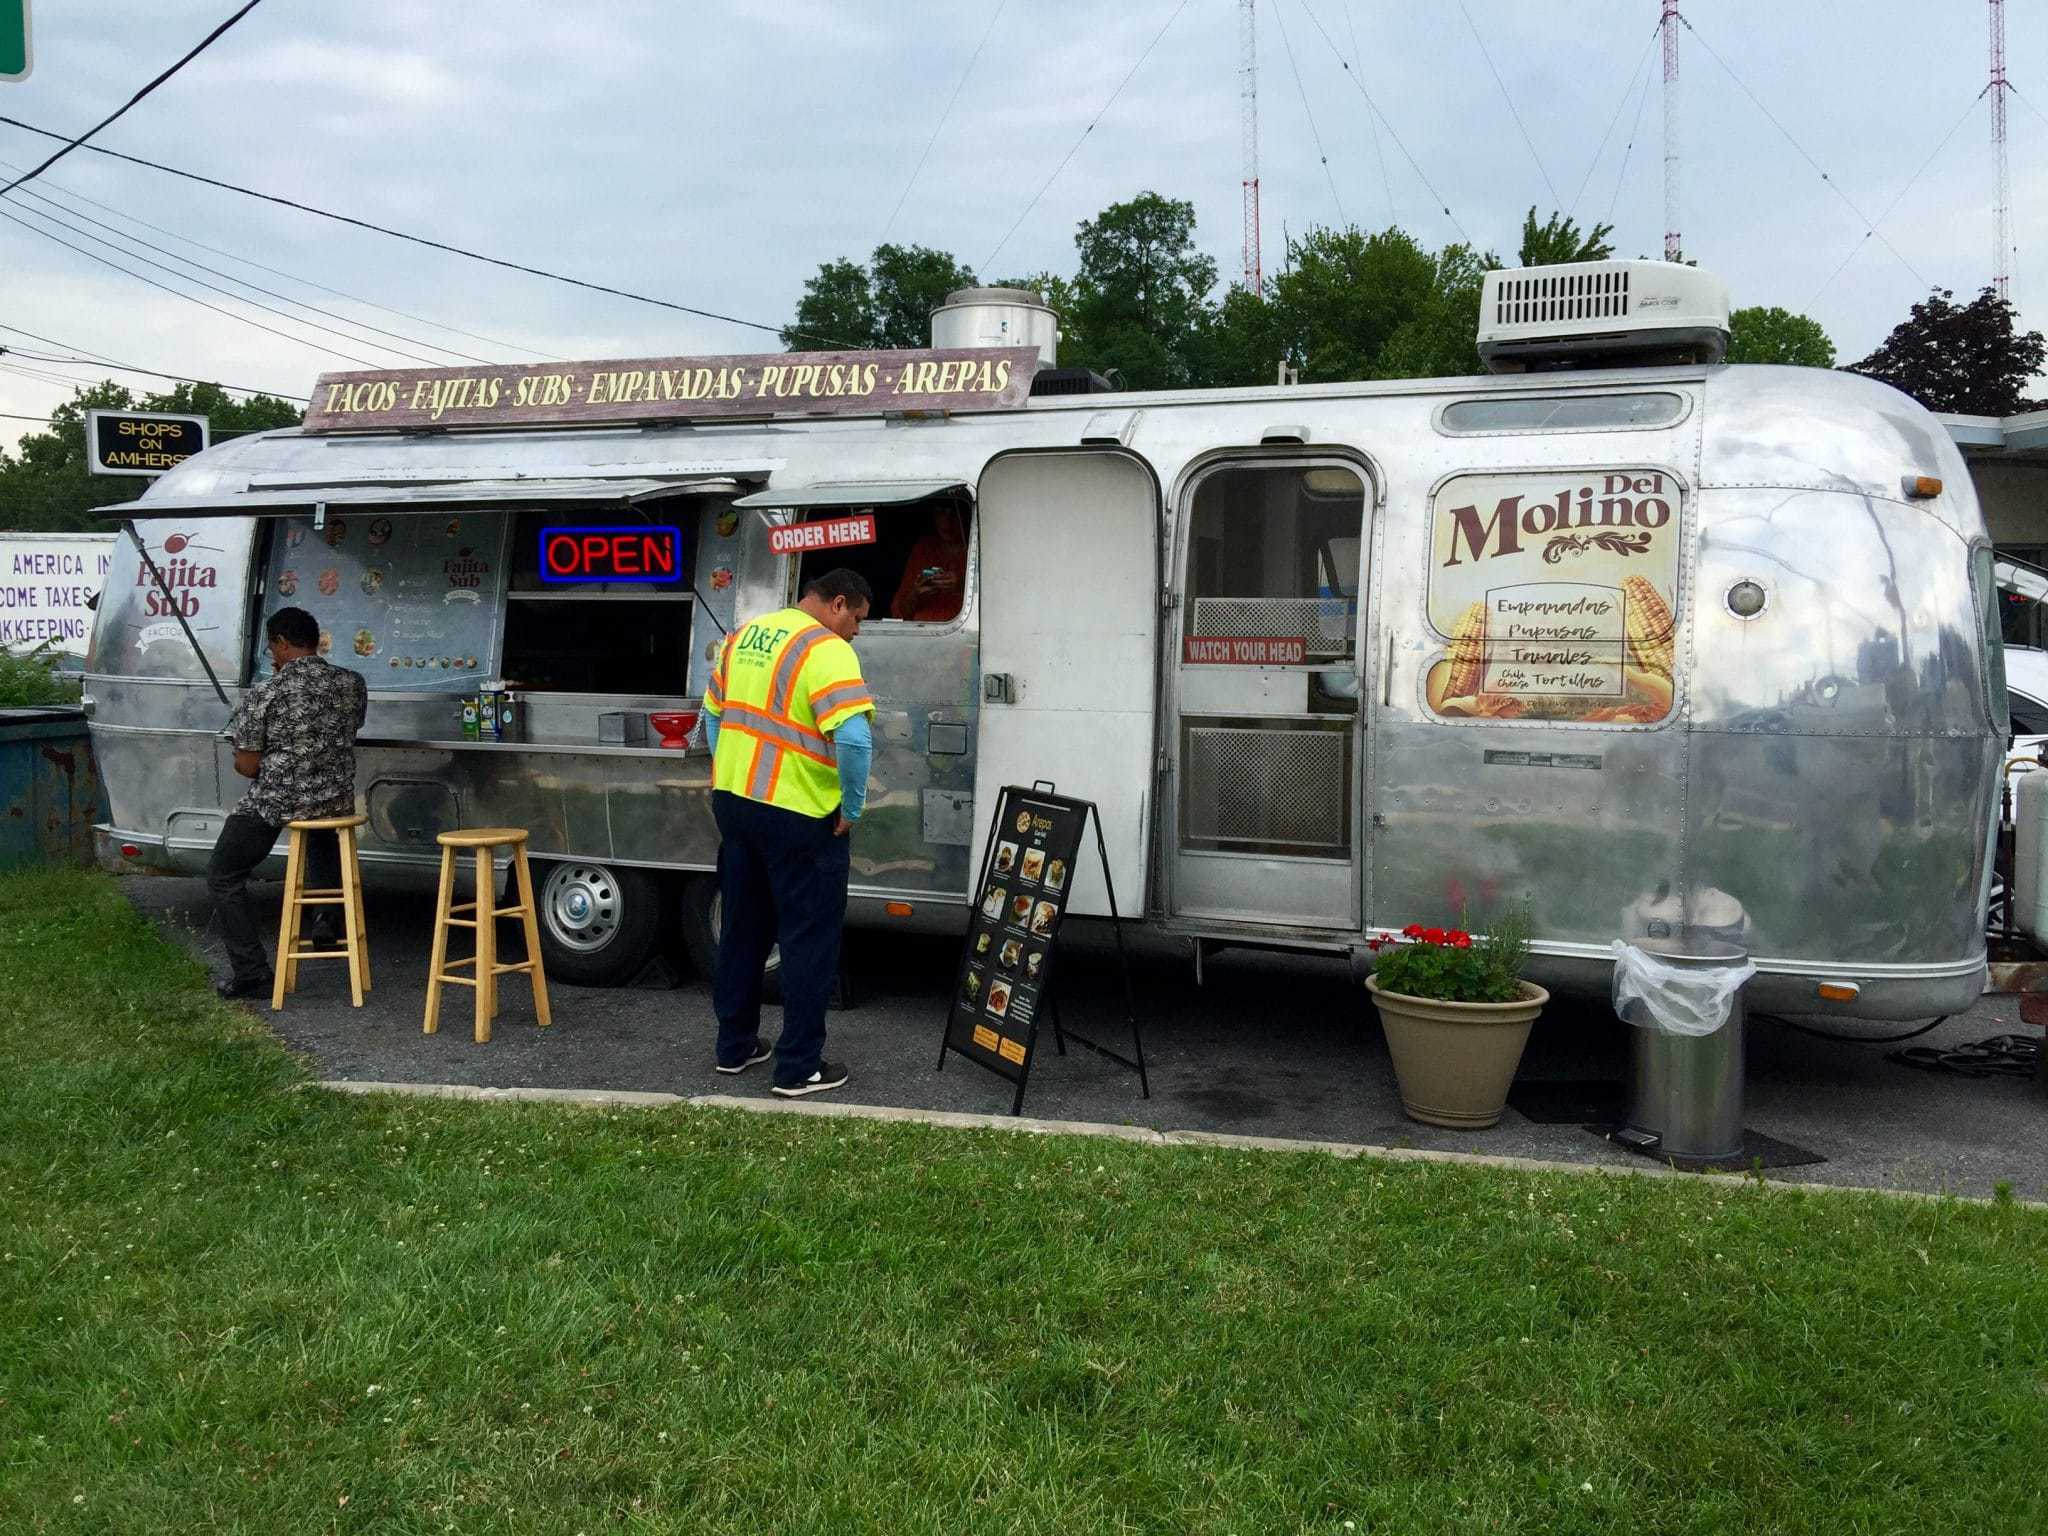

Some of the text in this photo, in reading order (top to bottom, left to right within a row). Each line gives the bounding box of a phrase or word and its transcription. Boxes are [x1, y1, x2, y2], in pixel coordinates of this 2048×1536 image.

[324, 359, 1012, 420] TACOS FAJITAS SUBS EMPANADAS PUPUSAS AREPAS
[119, 421, 183, 438] SHOPS
[139, 438, 162, 450] ON
[106, 451, 192, 467] AMHERS
[1602, 474, 1665, 496] Del
[772, 520, 871, 550] ORDER HERE
[1443, 487, 1671, 568] Molino
[13, 554, 83, 575] AMERICA
[547, 536, 673, 574] OPEN
[136, 558, 217, 592] Fajita
[449, 574, 481, 588] Sub
[45, 586, 92, 607] TAXES
[144, 589, 200, 617] Sub
[1498, 597, 1613, 616] Empanadas
[0, 618, 84, 640] KKEEPING
[737, 624, 789, 653] D&F
[1508, 624, 1600, 641] Pupusas
[1189, 641, 1302, 662] WATCH YOUR HEAD
[1511, 648, 1594, 665] Tamales
[1531, 673, 1606, 689] Tortillas
